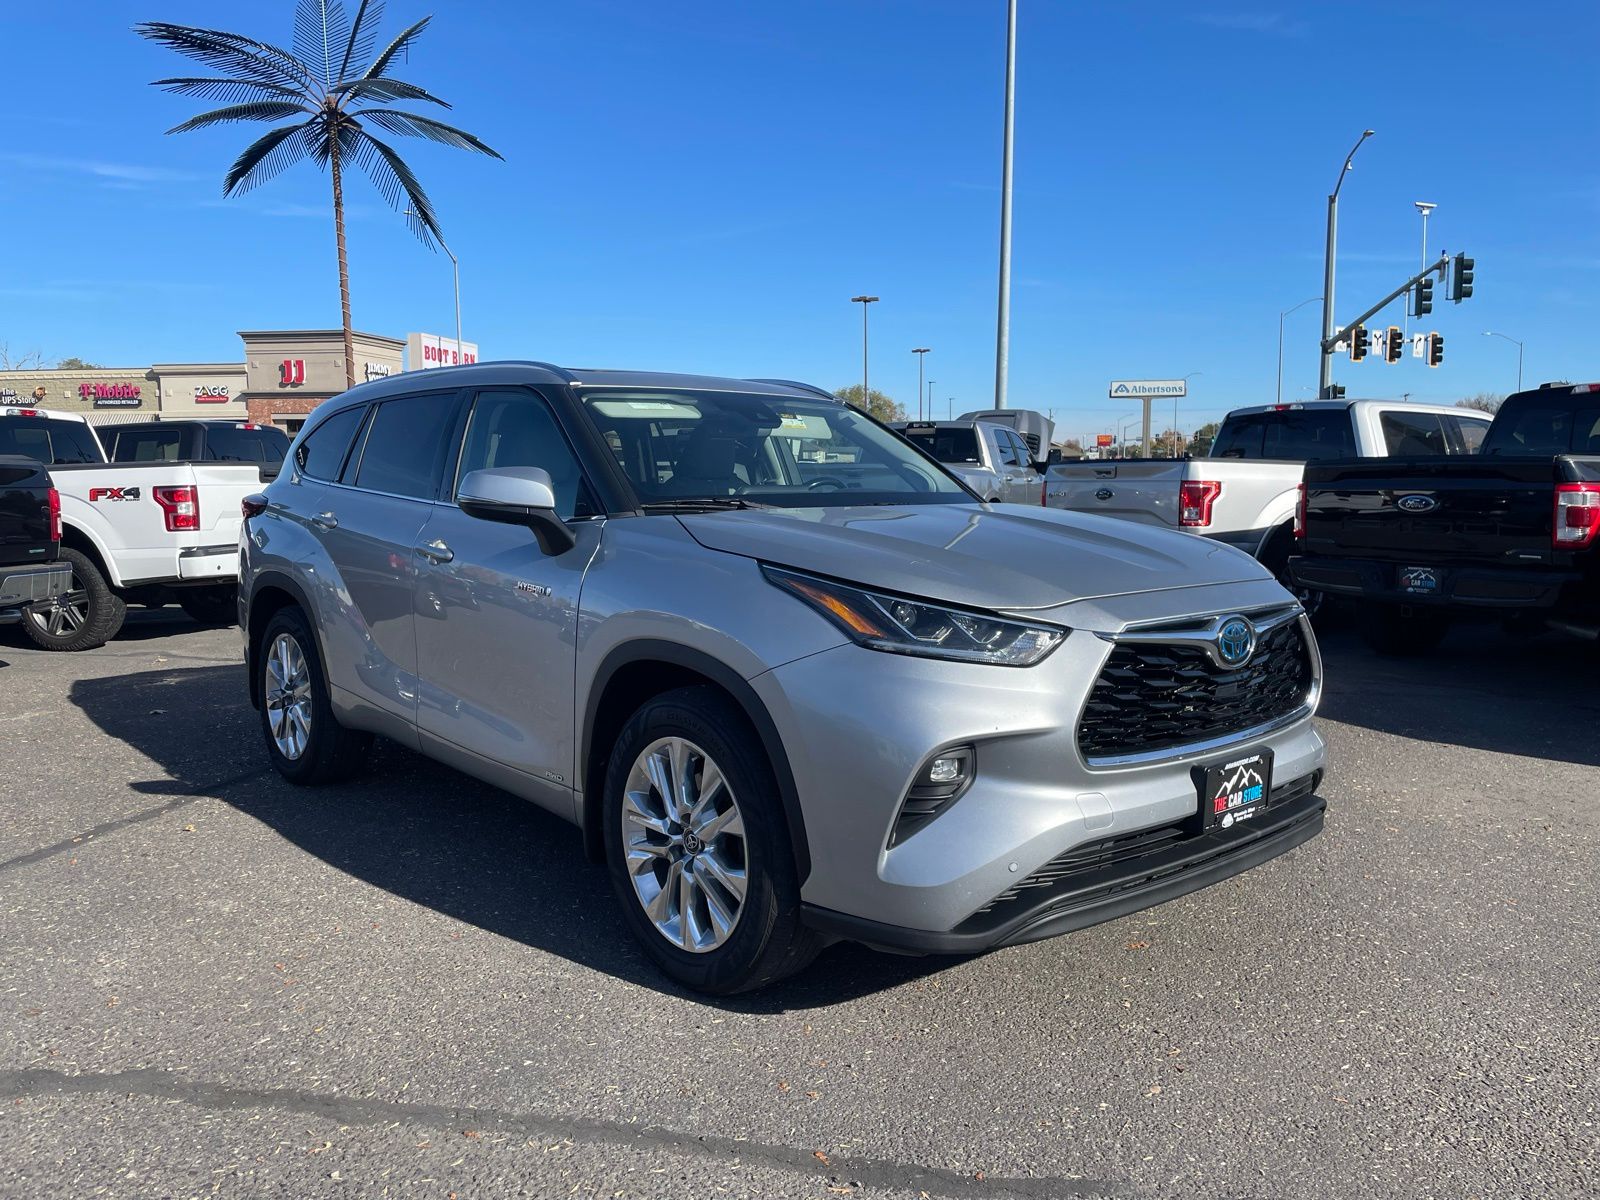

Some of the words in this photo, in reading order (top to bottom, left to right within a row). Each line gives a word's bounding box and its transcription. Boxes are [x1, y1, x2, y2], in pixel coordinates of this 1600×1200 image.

[424, 345, 449, 363] BOOT
[452, 351, 475, 365] BRN
[283, 360, 305, 383] JJ
[367, 362, 391, 375] JIMMY
[2, 388, 15, 396] The
[81, 382, 141, 398] T-Mobile
[196, 385, 228, 396] ZAGG
[1131, 385, 1183, 393] Albertsons
[2, 396, 16, 404] UPS
[17, 396, 36, 404] Store
[90, 487, 140, 501] FX4
[517, 581, 544, 593] HYBRID
[1214, 796, 1228, 812] THE
[1228, 791, 1243, 808] CAR
[1243, 784, 1263, 802] STORE
